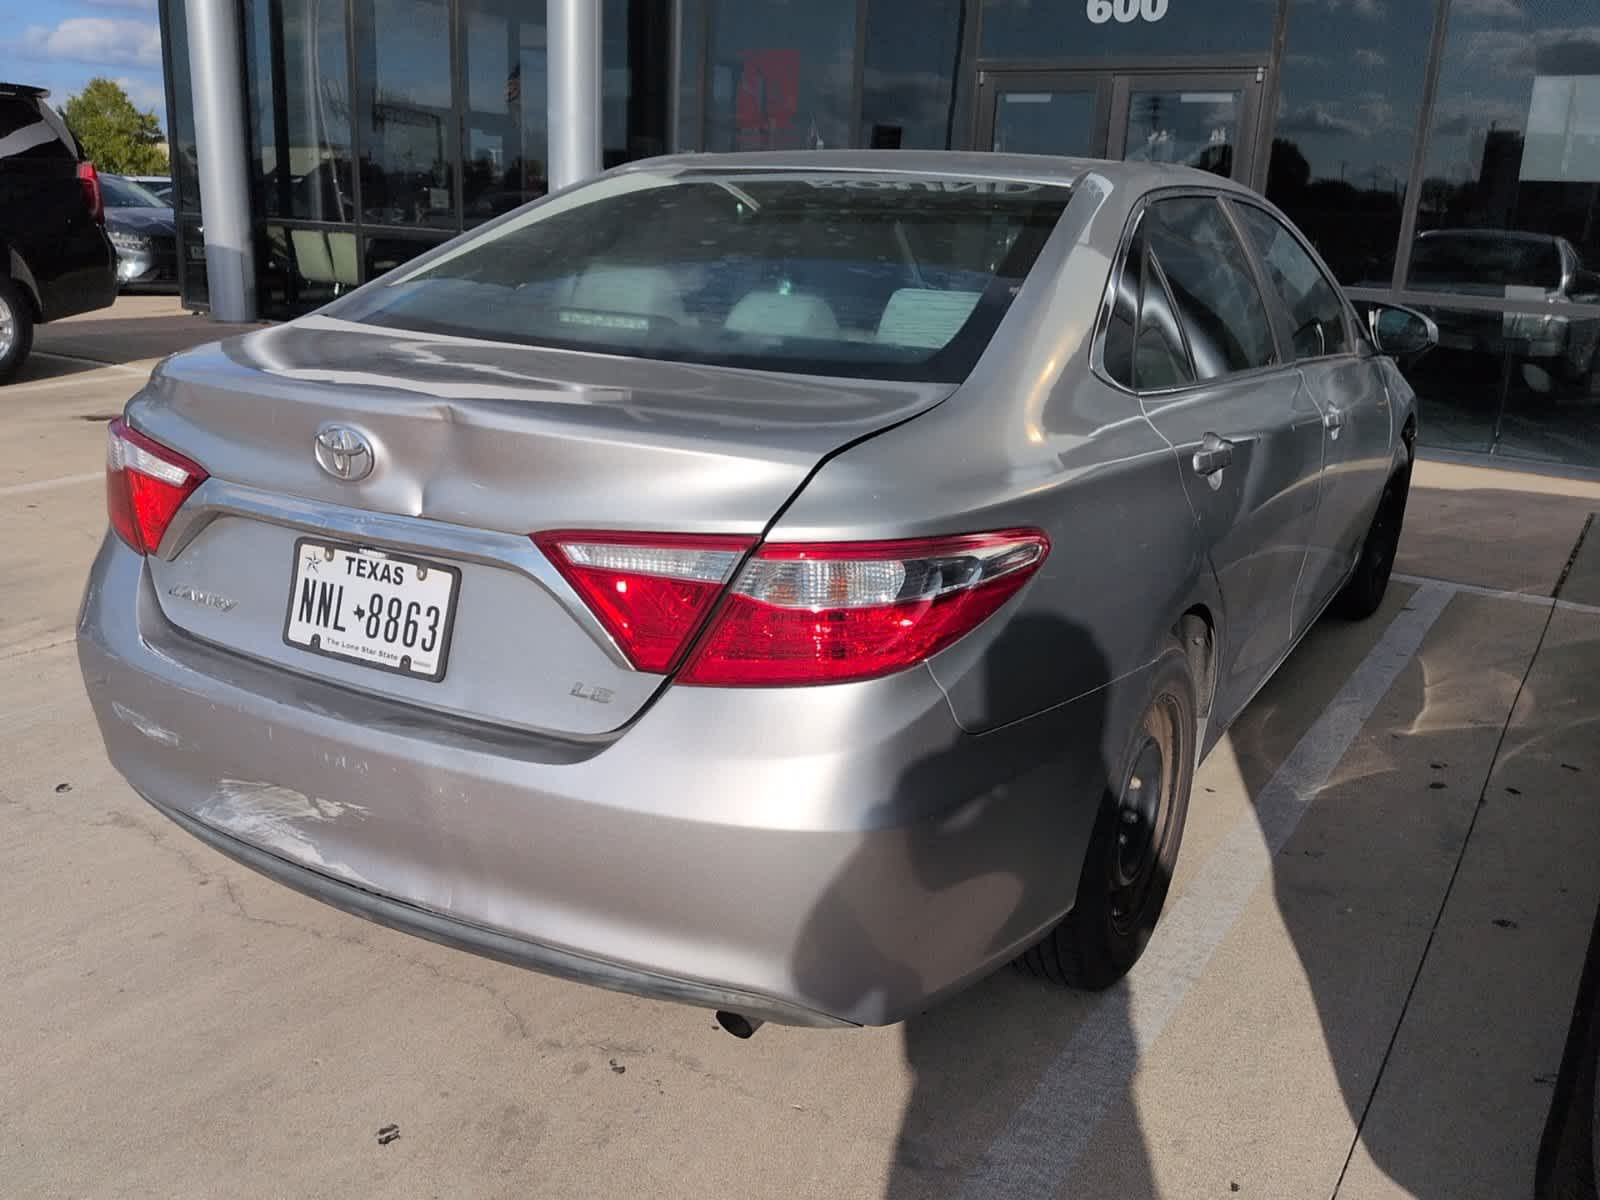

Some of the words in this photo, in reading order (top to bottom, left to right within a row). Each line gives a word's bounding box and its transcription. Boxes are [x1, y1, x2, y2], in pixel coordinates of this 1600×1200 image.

[1086, 0, 1169, 23] 600
[345, 556, 404, 585] TEXAS
[298, 577, 347, 632] NNL
[365, 593, 440, 652] 8863
[361, 645, 377, 656] Star
